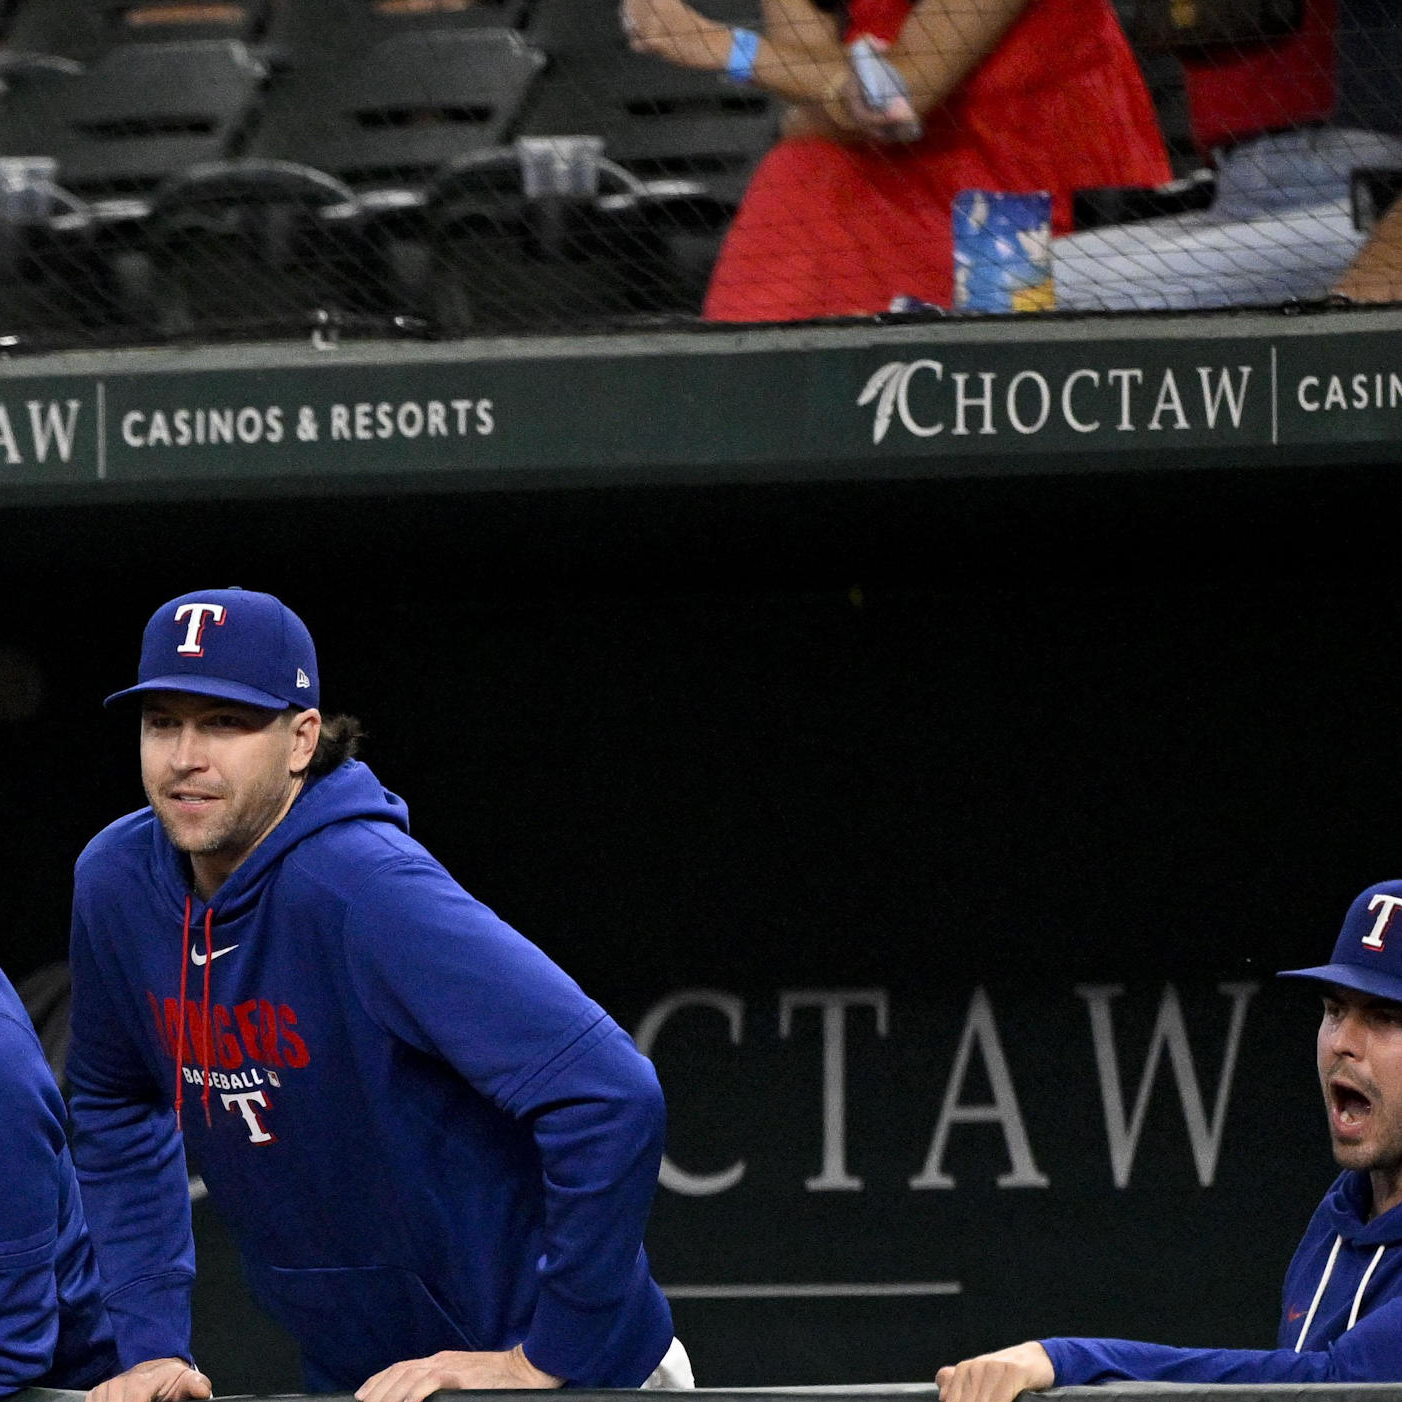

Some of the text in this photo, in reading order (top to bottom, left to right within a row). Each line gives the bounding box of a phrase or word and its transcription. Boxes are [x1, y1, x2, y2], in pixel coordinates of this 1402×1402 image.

[122, 406, 284, 448] CASINOS
[296, 406, 317, 442] &
[331, 398, 495, 440] RESORTS
[897, 359, 1252, 437] CHOCTAW
[174, 603, 227, 657] T
[1361, 893, 1402, 952] T
[220, 1091, 279, 1147] T
[634, 984, 1264, 1197] CTAW
